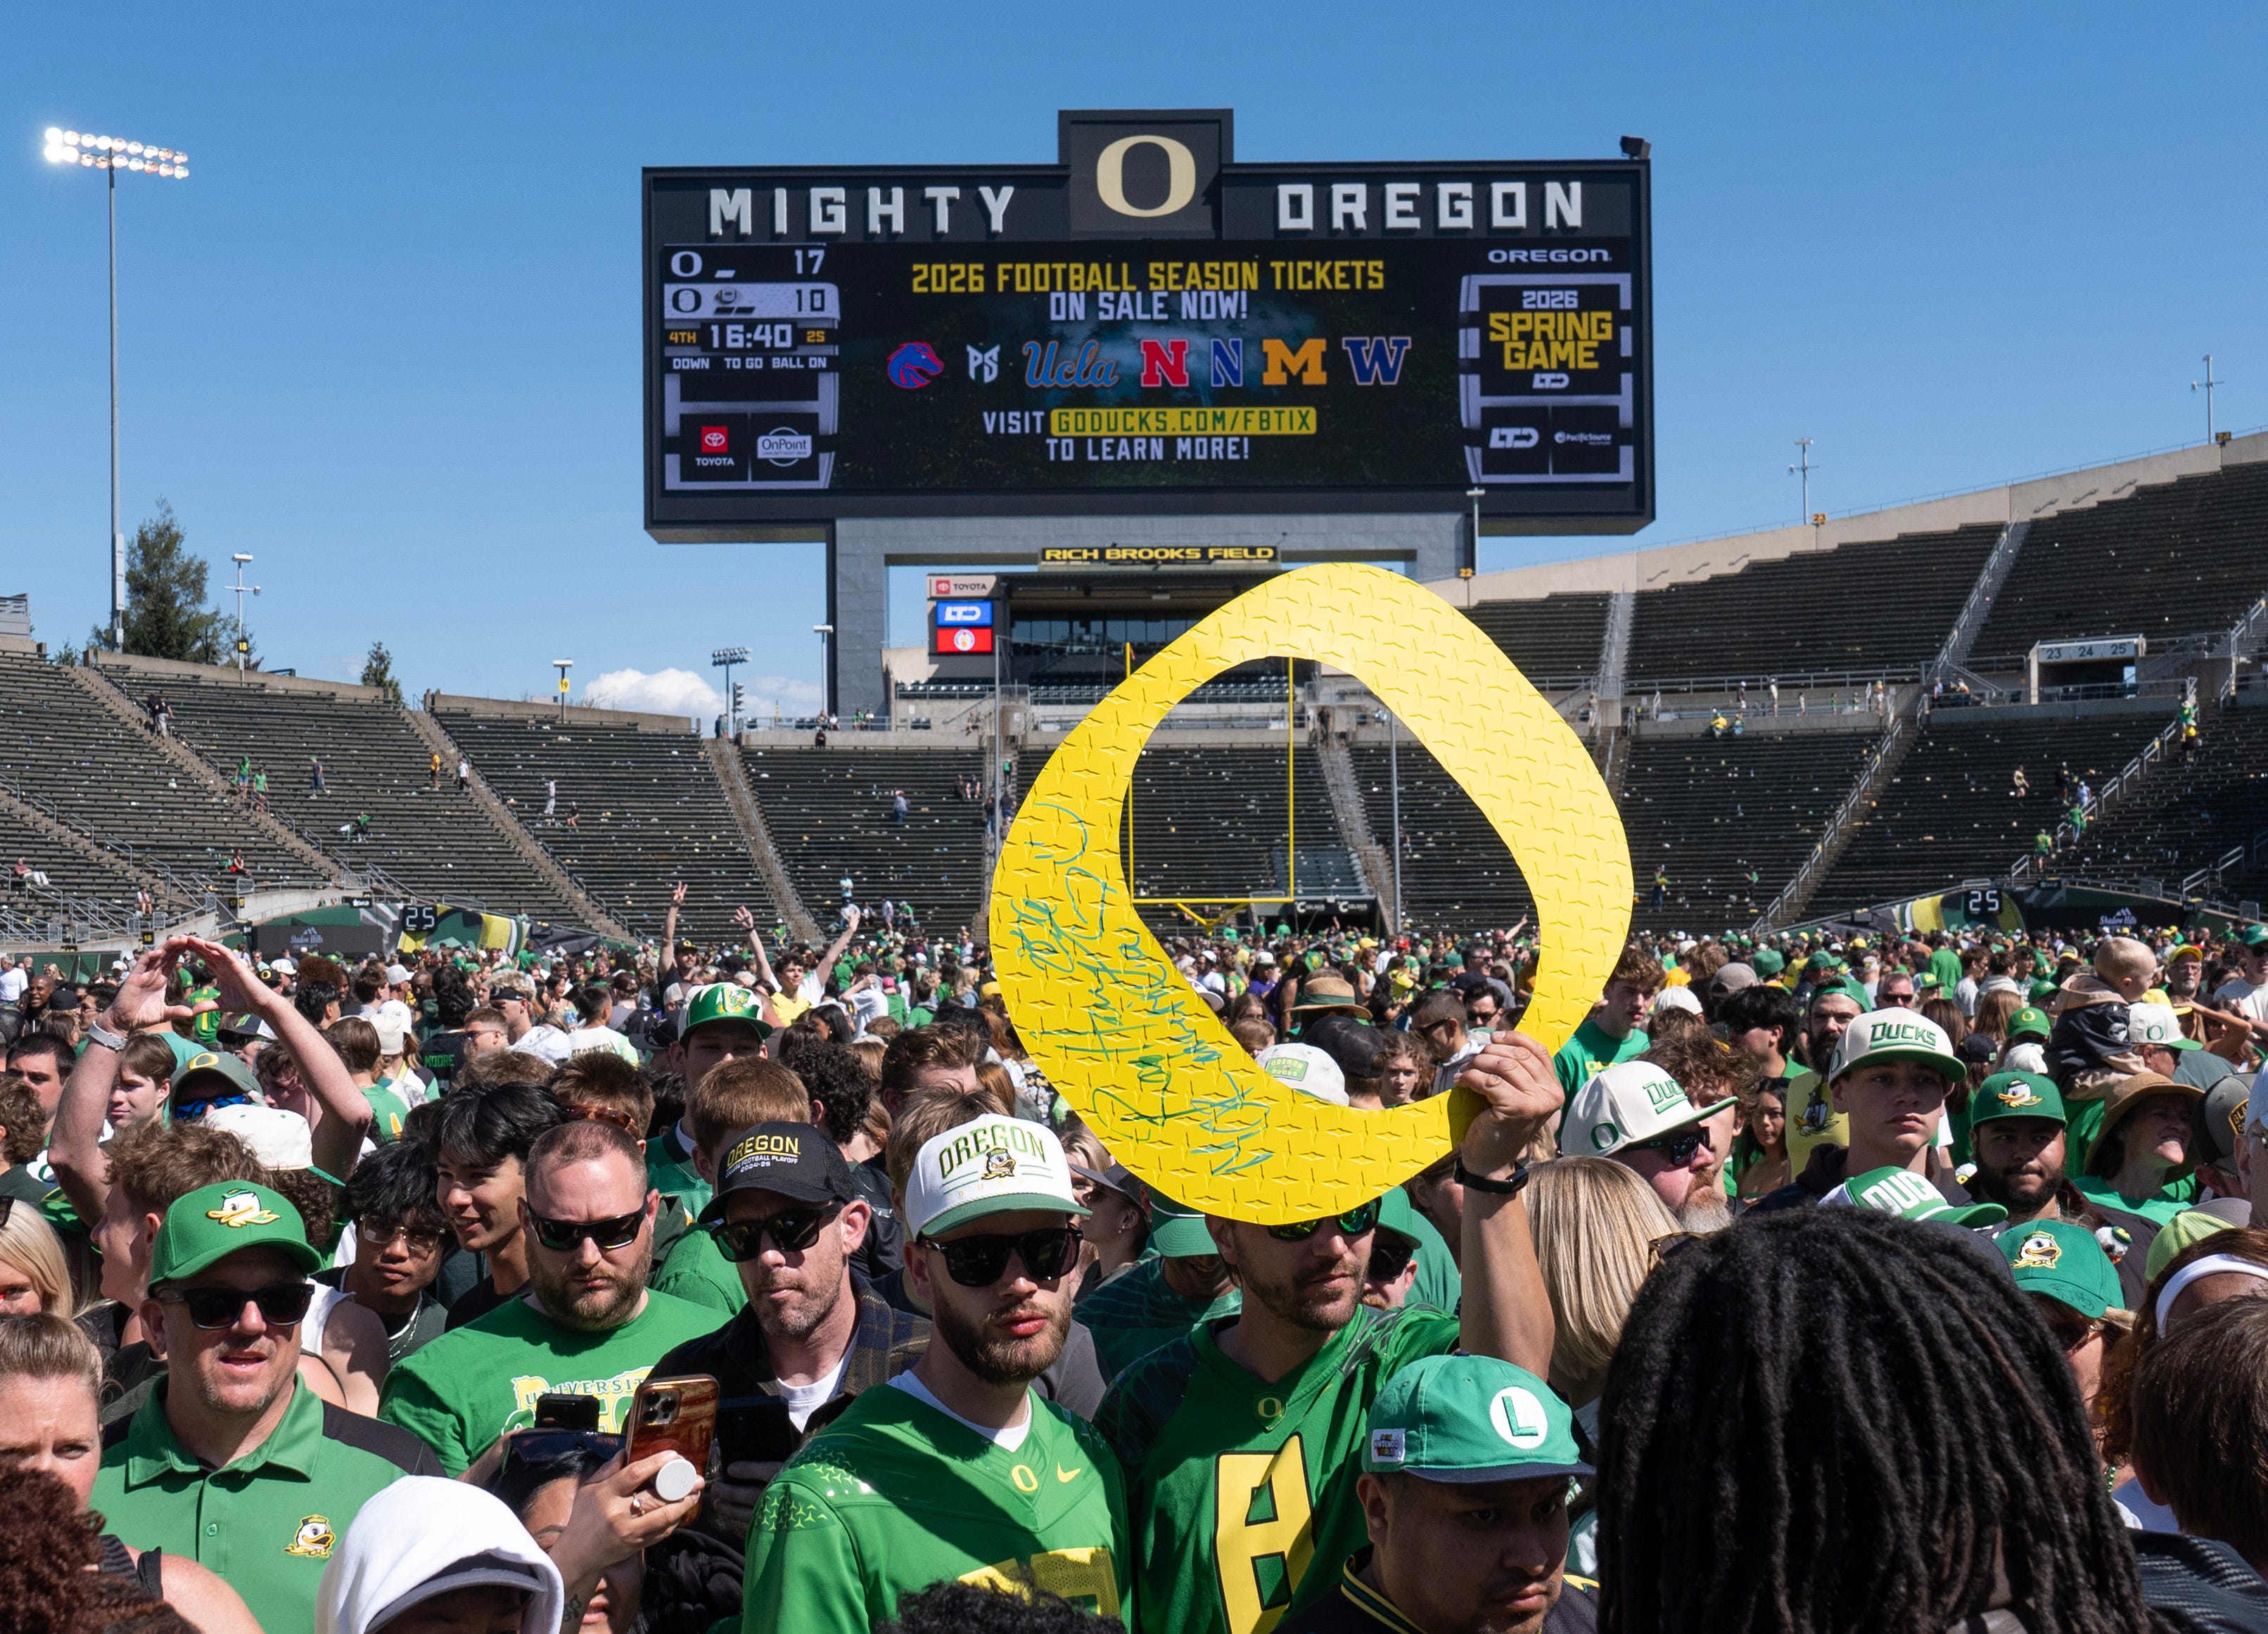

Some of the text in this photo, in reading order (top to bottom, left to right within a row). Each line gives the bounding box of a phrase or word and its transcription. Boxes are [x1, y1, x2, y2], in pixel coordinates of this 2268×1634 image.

[1097, 135, 1197, 218] O
[709, 186, 1014, 236] MIGHTY
[1277, 181, 1583, 231] OREGON
[670, 250, 702, 277] O
[794, 249, 825, 274] 17
[912, 260, 1384, 293] 2026 FOOTBALL SEASON TICKETS
[672, 288, 702, 313] O
[796, 288, 825, 312] 10
[1050, 290, 1247, 321] ON SALE NOW!
[1522, 290, 1578, 309] 2026
[669, 331, 696, 344] 4TH
[711, 324, 792, 349] 16:40
[806, 330, 825, 343] 25
[1489, 311, 1612, 342] SPRING
[673, 357, 710, 370] DOWN
[724, 357, 763, 369] TO GO
[772, 357, 827, 369] BALL ON
[1140, 338, 1189, 387] N
[1210, 338, 1243, 387] N
[1262, 338, 1327, 385] M
[1342, 336, 1412, 385] W
[1504, 340, 1599, 370] GAME
[983, 409, 1311, 435] VISIT GODUCKS.COM/FBTIX
[762, 438, 807, 450] OnPoint
[1045, 436, 1249, 461] TO LEARN MORE!
[695, 457, 735, 466] TOYOTA
[1045, 547, 1274, 561] RICH BROOKS FIELD
[2046, 643, 2127, 660] 23 24 25
[1969, 889, 1999, 912] 25
[406, 907, 435, 928] 25
[260, 970, 272, 980] O
[2020, 1011, 2035, 1021] O
[1870, 1022, 1936, 1047] DUCKS
[2147, 1024, 2165, 1040] O
[424, 1054, 455, 1068] MOORE
[1271, 1059, 1304, 1070] OREGON
[1643, 1079, 1686, 1106] DUC
[1591, 1121, 1620, 1151] O
[727, 1135, 799, 1168] OREGON
[741, 1154, 771, 1167] FOOTBALL
[771, 1155, 798, 1165] PLAYOFF
[939, 1124, 1046, 1179] OREGON
[1861, 1170, 1947, 1217] DUC
[525, 1377, 645, 1405] UIVERSIT
[1258, 1397, 1282, 1418] O
[1502, 1395, 1538, 1436] L
[1012, 1464, 1038, 1493] O
